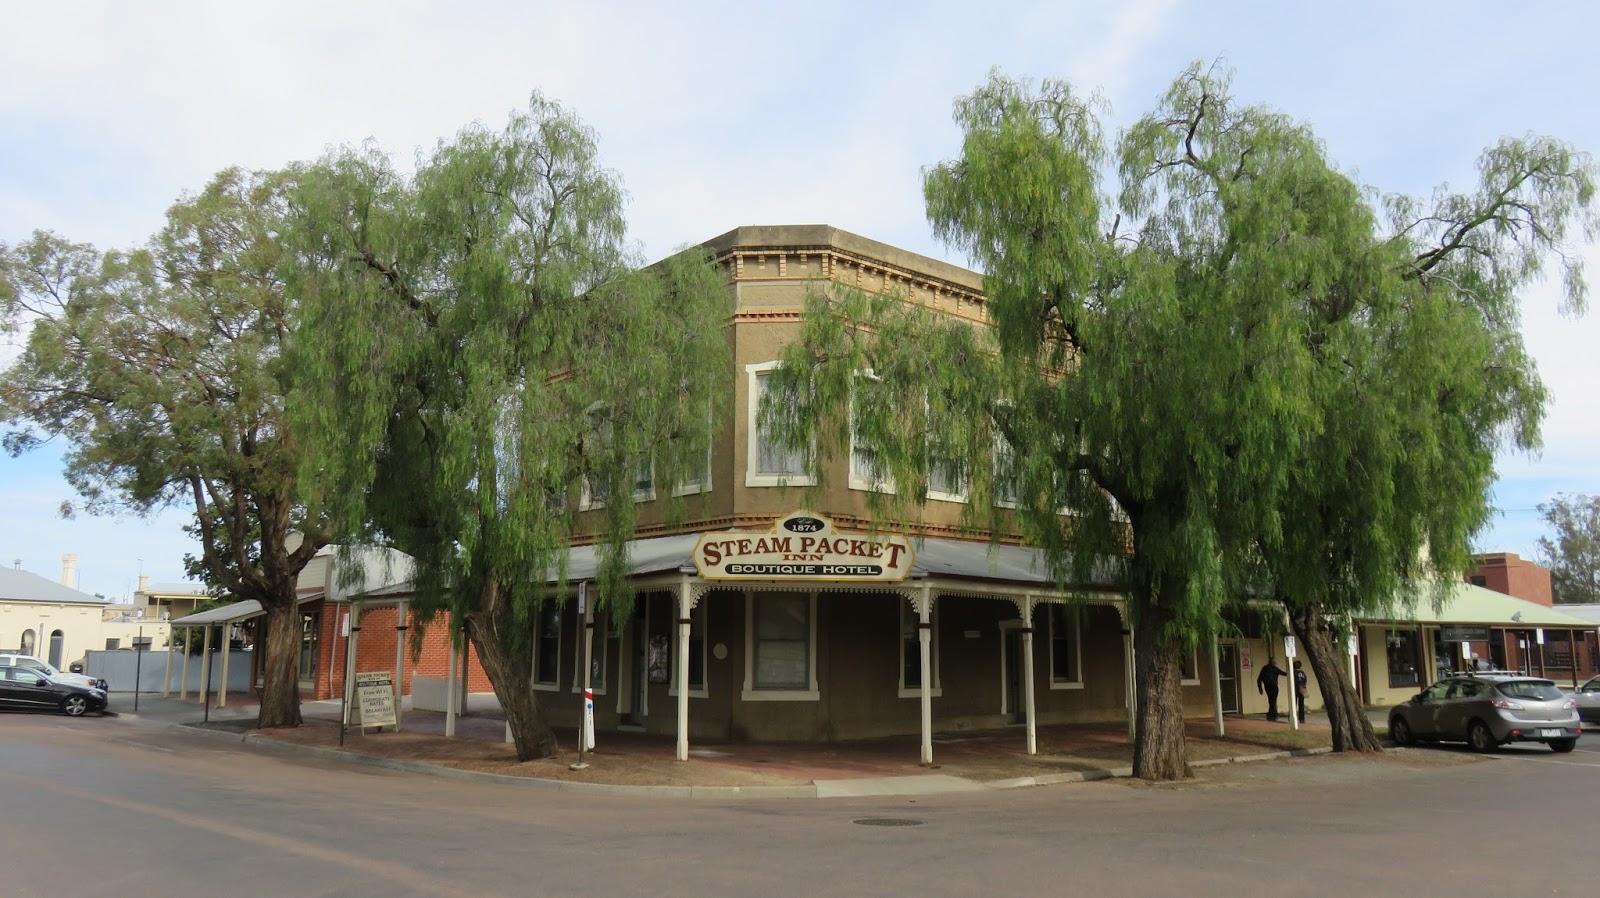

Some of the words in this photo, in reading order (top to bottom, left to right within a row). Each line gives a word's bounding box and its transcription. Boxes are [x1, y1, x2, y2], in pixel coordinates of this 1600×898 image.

[792, 524, 817, 532] 1874
[702, 537, 792, 567] STEAM
[800, 537, 906, 569] PACKET
[731, 564, 815, 574] BOUTIQUE
[823, 565, 878, 574] HOTEL
